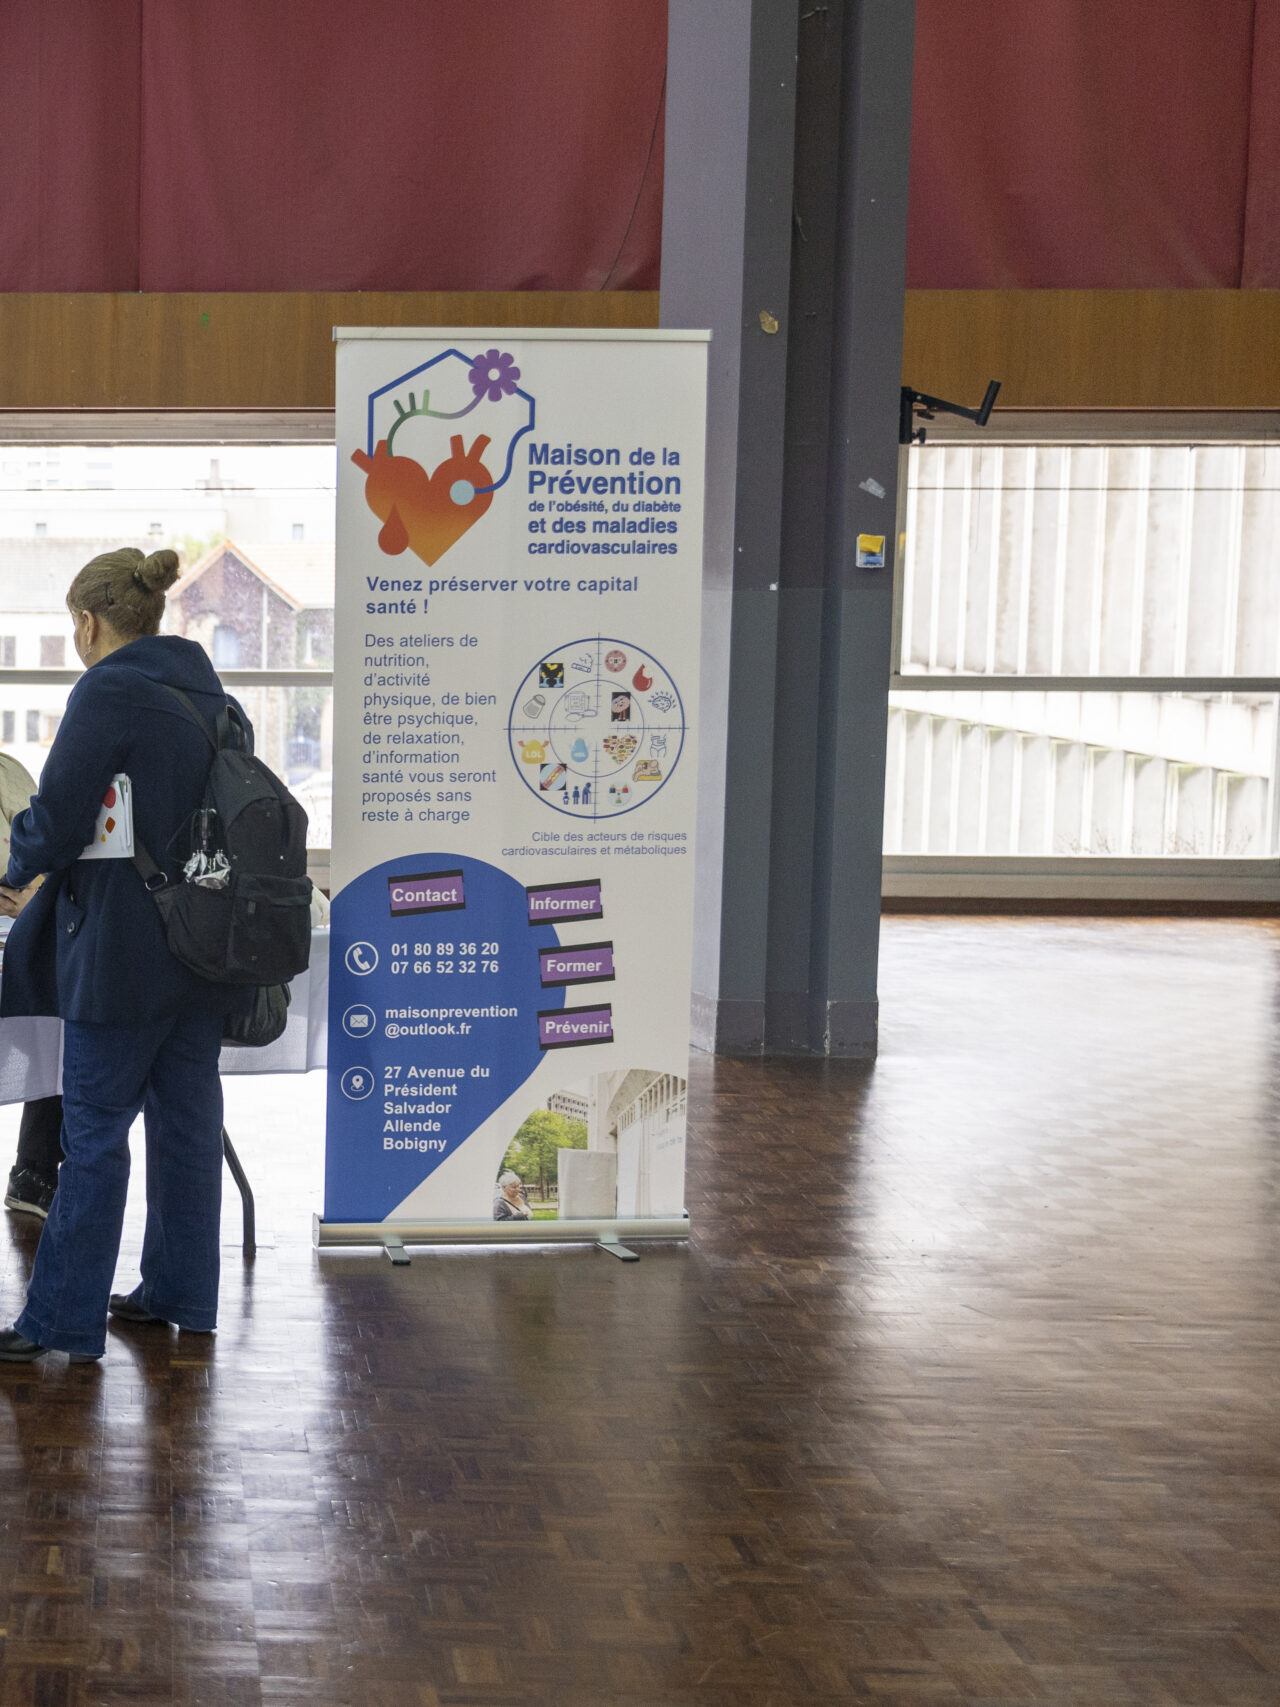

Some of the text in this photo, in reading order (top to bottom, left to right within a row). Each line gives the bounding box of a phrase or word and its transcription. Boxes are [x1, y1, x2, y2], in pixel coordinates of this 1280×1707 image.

[529, 443, 680, 466] Maison de la
[529, 470, 681, 495] Prévention
[529, 501, 545, 512] de
[612, 501, 629, 512] du
[633, 501, 681, 512] diabète
[528, 518, 678, 534] et des maladies
[528, 540, 678, 555] cardiovasculaires
[367, 577, 638, 595] Venez préserver votre capital
[366, 600, 428, 614] santé !
[365, 634, 478, 648] Des ateliers de
[364, 654, 429, 669] nutrition,
[364, 693, 496, 709] physique, de bien
[363, 712, 478, 728] être psychique,
[363, 731, 464, 747] de relaxation,
[362, 770, 496, 783] santé vous seront
[362, 789, 472, 805] proposés sans
[362, 808, 470, 824] reste à charge
[532, 831, 687, 843] Cible des acteurs de risques
[502, 845, 687, 857] cardiovasculaires et métaboliques
[392, 888, 457, 902] Contact
[530, 898, 595, 910] Informer
[392, 943, 499, 956] 01 80 89 36 20
[391, 961, 499, 974] 07 66 52 32 76
[547, 959, 601, 972] Former
[385, 1006, 517, 1021] maisonprevention
[385, 1023, 471, 1038] @outlook.fr
[546, 1021, 610, 1034] Prévenir
[384, 1066, 490, 1079] 27 Avenue du
[384, 1084, 457, 1097] Président
[384, 1103, 451, 1114] Salvador
[383, 1120, 441, 1132] Allende
[384, 1138, 446, 1152] Bobigny
